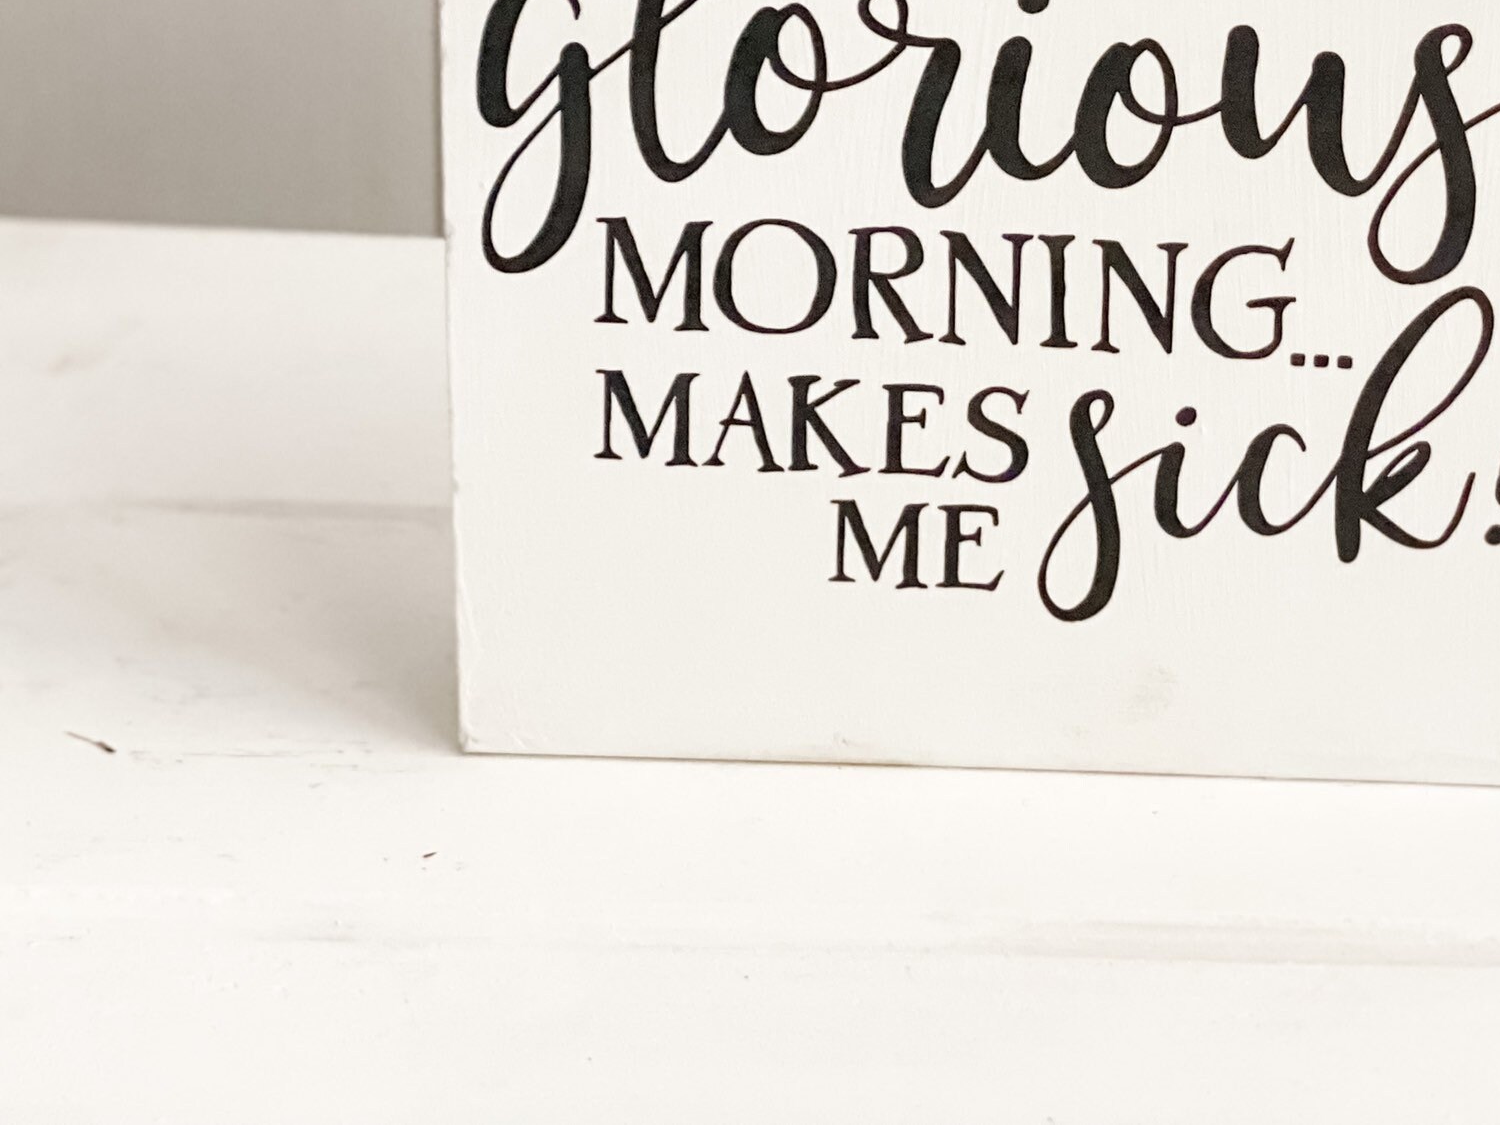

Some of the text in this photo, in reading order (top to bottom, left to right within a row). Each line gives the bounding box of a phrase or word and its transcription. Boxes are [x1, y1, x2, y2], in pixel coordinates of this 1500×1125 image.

[594, 215, 1354, 368] MORNING...
[594, 369, 1030, 484] MAKES
[828, 499, 1005, 592] ME
